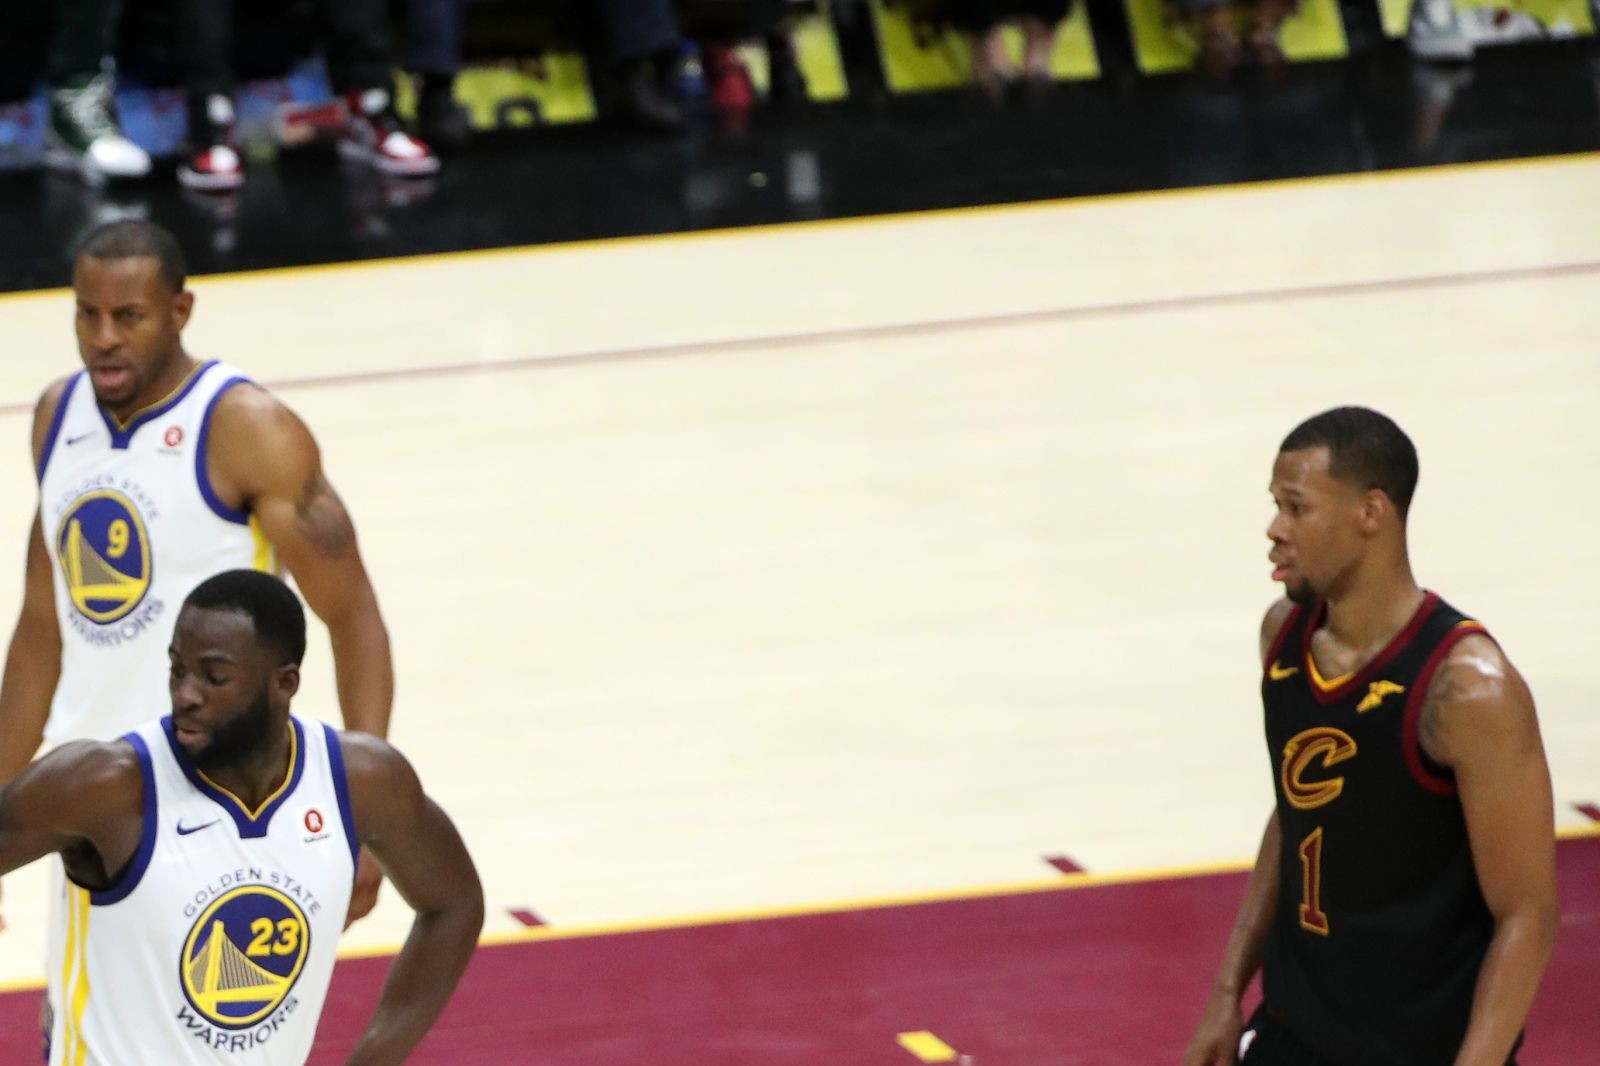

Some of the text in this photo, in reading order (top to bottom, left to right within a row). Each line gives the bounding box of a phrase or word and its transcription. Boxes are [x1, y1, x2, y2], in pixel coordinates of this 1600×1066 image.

[106, 518, 130, 558] 9
[1281, 726, 1357, 810] C
[184, 867, 323, 919] GOLDEN STATE
[1300, 826, 1329, 937] 1
[245, 916, 301, 957] 23
[176, 995, 299, 1053] WARRIORS
